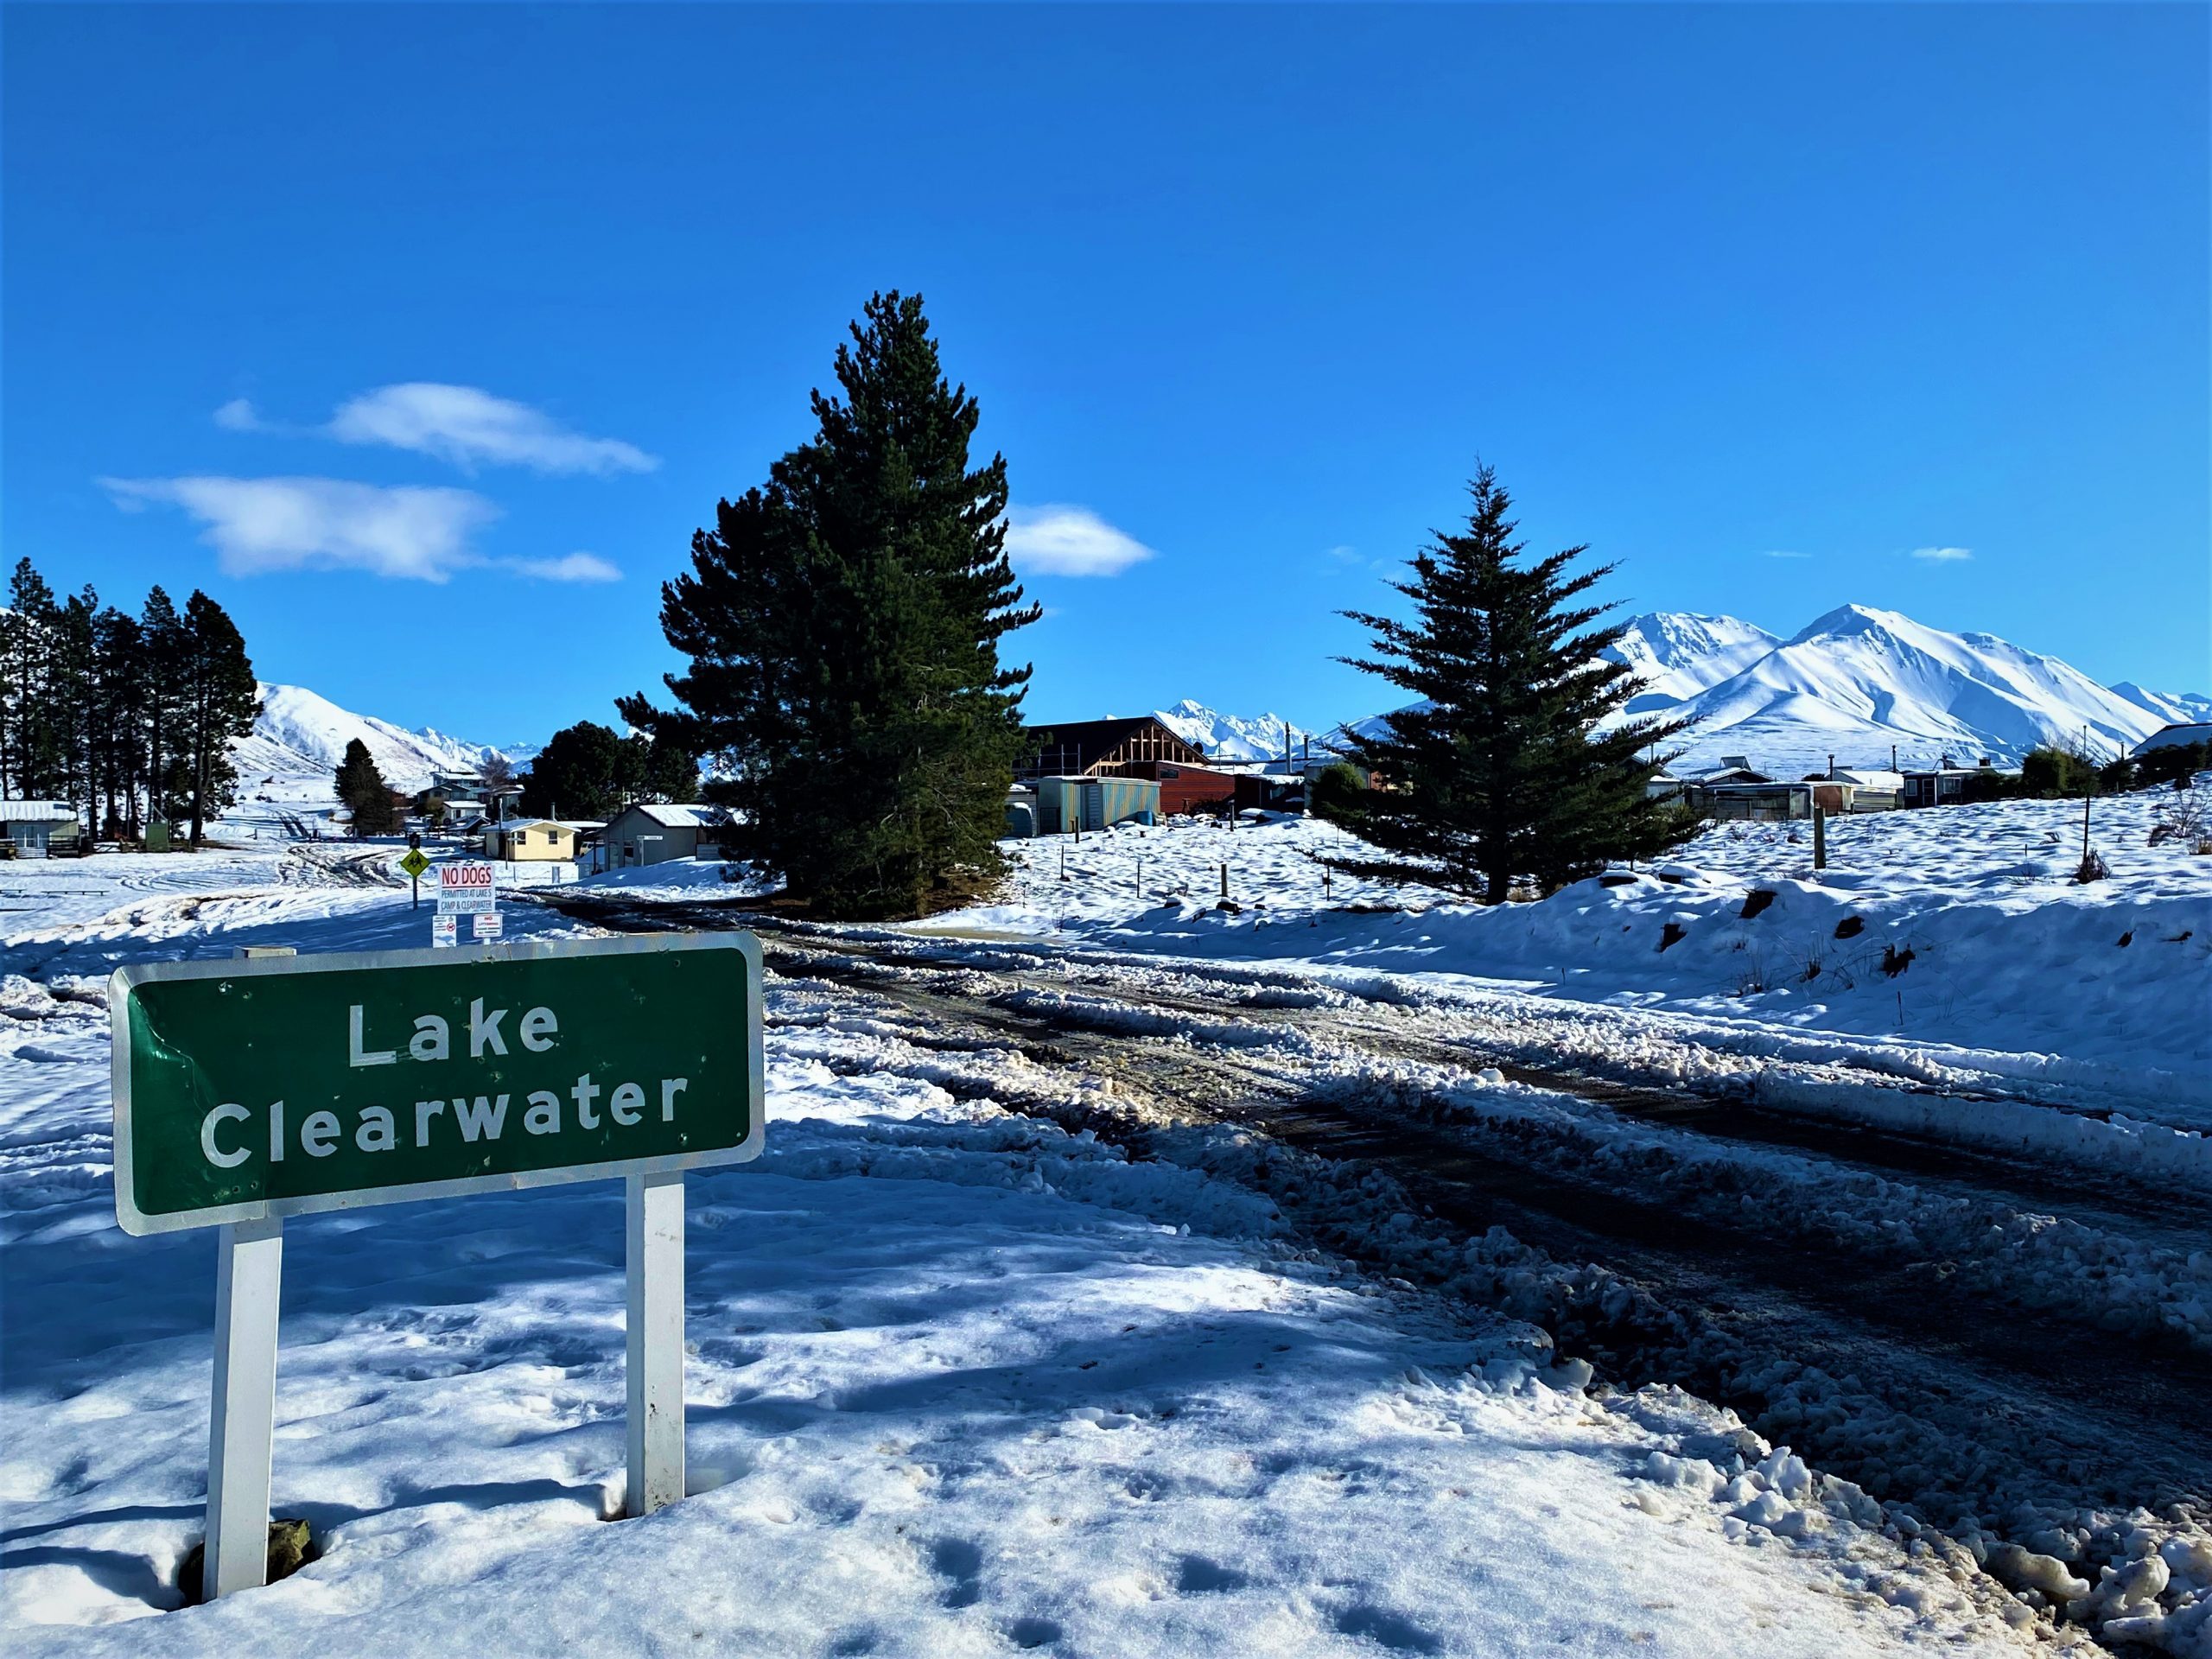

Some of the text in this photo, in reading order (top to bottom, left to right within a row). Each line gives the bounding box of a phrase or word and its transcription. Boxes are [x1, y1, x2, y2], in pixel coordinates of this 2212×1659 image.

[442, 866, 492, 885] NO DOGS
[441, 889, 468, 899] PERMITTED
[469, 888, 476, 898] AT
[441, 899, 492, 910] CAMP & CLEARWATER
[349, 997, 558, 1067] Lake
[200, 1073, 688, 1168] Clearwater
